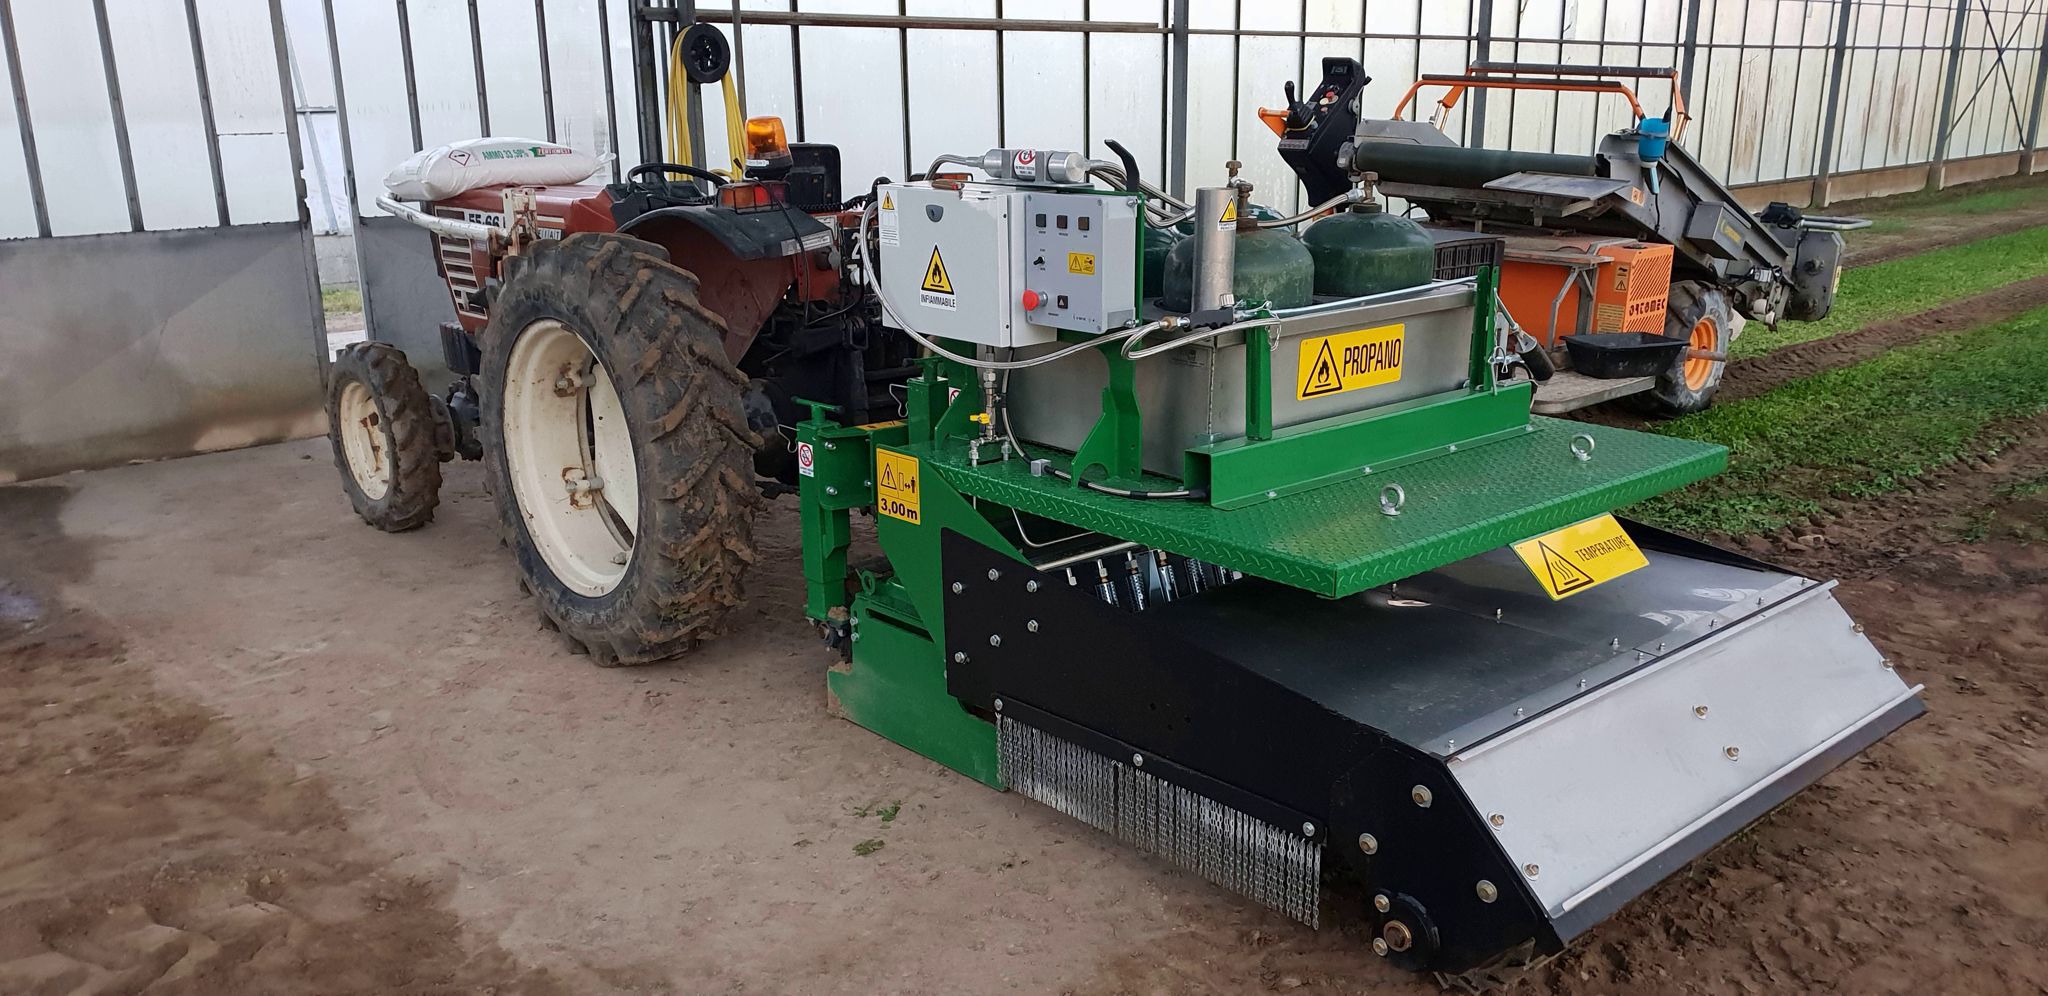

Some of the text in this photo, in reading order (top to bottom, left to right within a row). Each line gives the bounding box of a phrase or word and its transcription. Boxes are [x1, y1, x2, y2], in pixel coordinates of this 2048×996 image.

[482, 150, 505, 161] AMMO
[920, 294, 956, 309] INFIAMMABILE
[1342, 338, 1401, 378] PROPANO
[1574, 535, 1630, 562] TEMPERATURE
